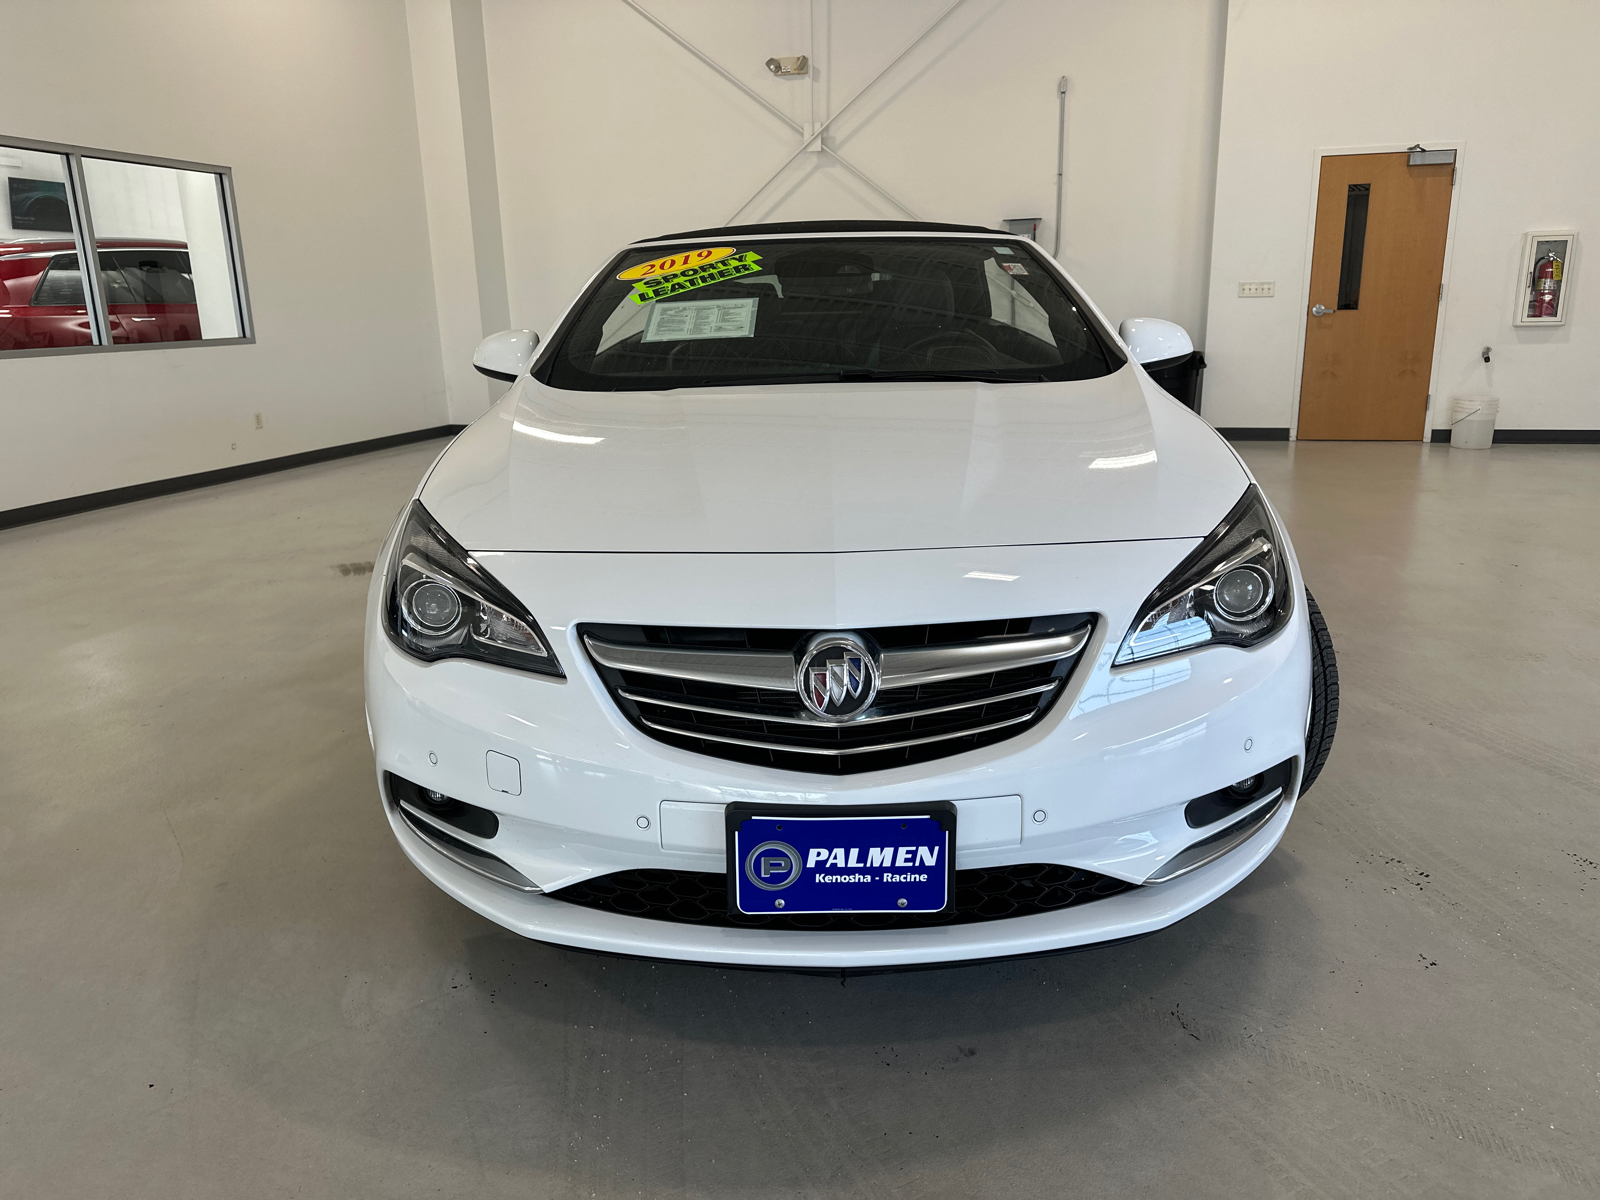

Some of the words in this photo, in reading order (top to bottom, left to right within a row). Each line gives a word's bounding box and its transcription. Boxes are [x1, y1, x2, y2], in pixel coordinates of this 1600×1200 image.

[640, 249, 713, 277] 2019
[643, 253, 748, 288] SPORTY
[638, 263, 752, 302] LEATHER
[806, 845, 940, 868] PALMEN
[815, 873, 872, 883] Kenosha
[883, 872, 928, 883] Racine
